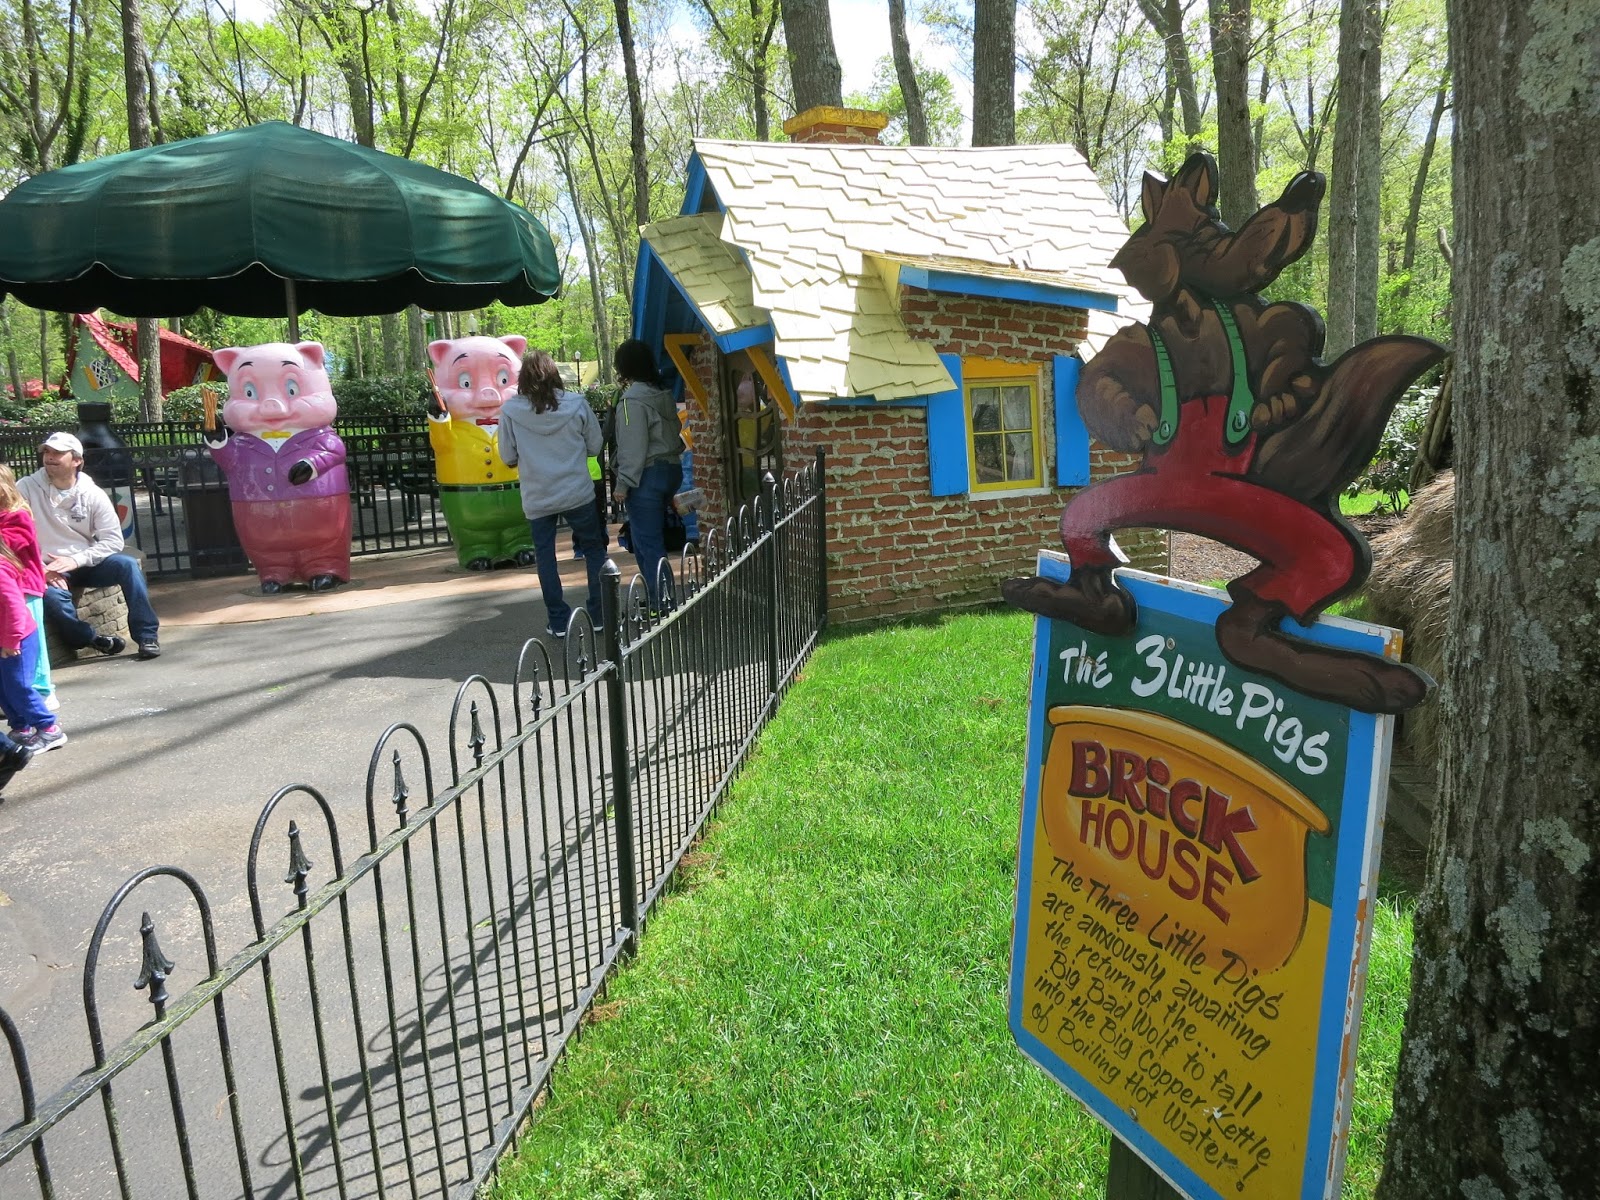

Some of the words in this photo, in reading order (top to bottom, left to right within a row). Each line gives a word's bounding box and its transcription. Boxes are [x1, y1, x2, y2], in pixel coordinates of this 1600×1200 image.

[1168, 653, 1234, 716] Little
[1236, 682, 1330, 775] Pigs
[1080, 800, 1234, 926] HOUSE
[1042, 892, 1075, 921] are
[1077, 914, 1166, 989] anxiously
[1172, 978, 1271, 1060] awaiting
[1045, 920, 1071, 949] the
[1075, 944, 1136, 993] return
[1137, 986, 1162, 1008] of
[1050, 856, 1083, 893] The
[1086, 878, 1139, 932] Three
[1147, 913, 1206, 975] Little
[1213, 948, 1284, 1020] Pigs
[1031, 1002, 1054, 1034] of
[1057, 1016, 1121, 1085] Boiling
[1124, 1070, 1159, 1108] Hot
[1033, 969, 1066, 1005] into
[1067, 995, 1096, 1029] the
[1099, 1016, 1134, 1060] Big
[1138, 1048, 1208, 1109] Copper
[1207, 1103, 1272, 1167] Kettle
[1049, 950, 1081, 990] Big
[1086, 976, 1133, 1021] Bad
[1131, 1007, 1179, 1055] Wolf
[1183, 1051, 1205, 1081] to
[1210, 1068, 1263, 1118] fall
